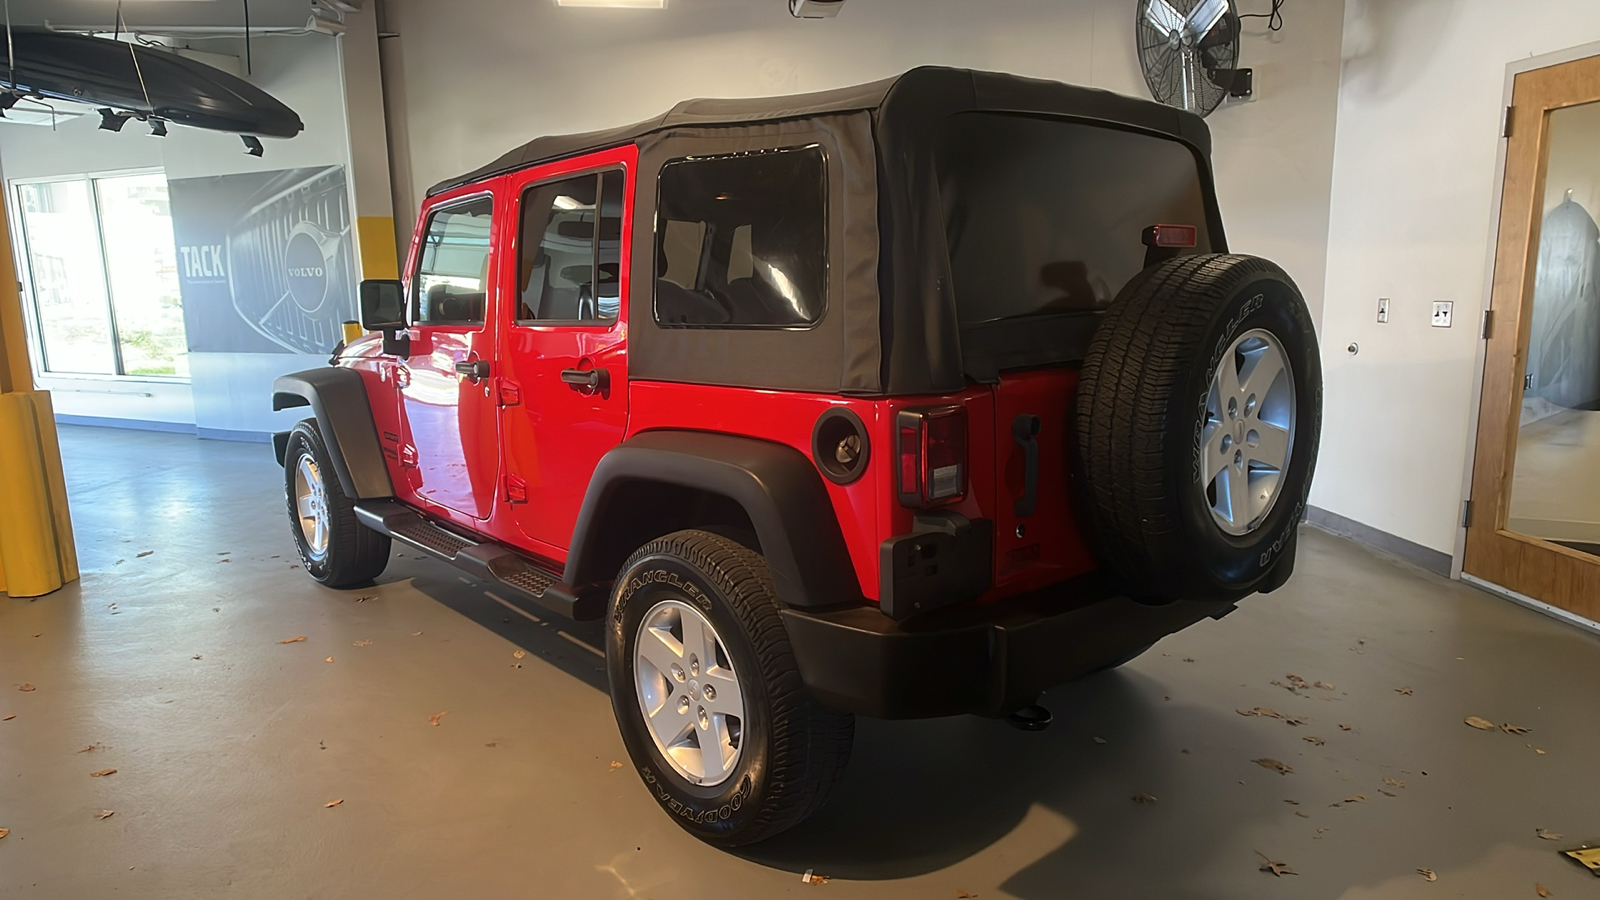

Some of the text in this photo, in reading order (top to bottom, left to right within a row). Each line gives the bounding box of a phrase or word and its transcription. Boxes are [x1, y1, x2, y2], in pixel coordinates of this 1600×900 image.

[180, 245, 225, 277] TACK
[288, 267, 323, 277] VOLVO
[1192, 293, 1264, 484] WRANGLER
[613, 569, 712, 623] WRANGLER
[641, 766, 752, 824] GOODYEAR
